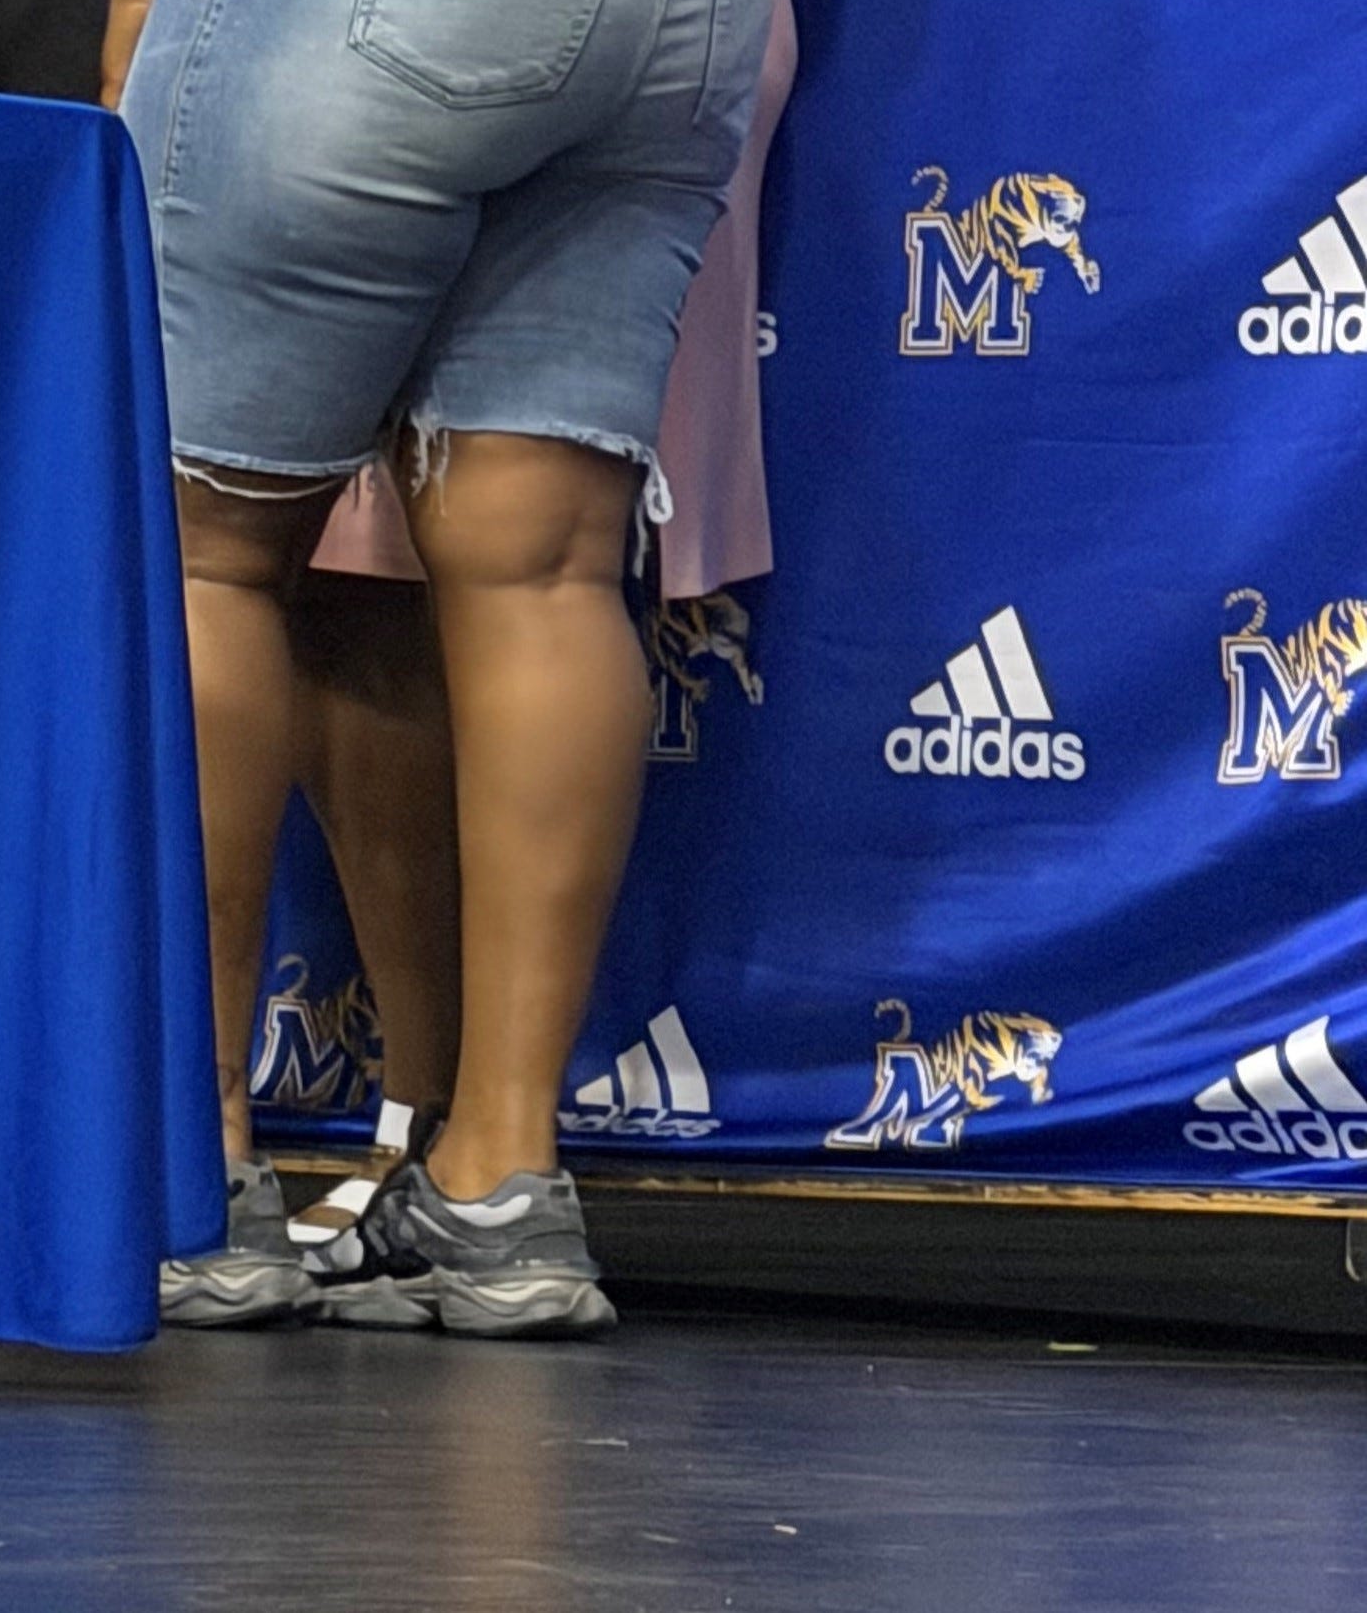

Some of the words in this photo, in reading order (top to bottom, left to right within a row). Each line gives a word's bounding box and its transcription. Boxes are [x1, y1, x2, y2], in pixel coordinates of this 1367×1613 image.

[899, 212, 1030, 356] M
[884, 715, 1085, 781] adidas
[1217, 635, 1341, 785] M
[823, 1042, 967, 1150] M
